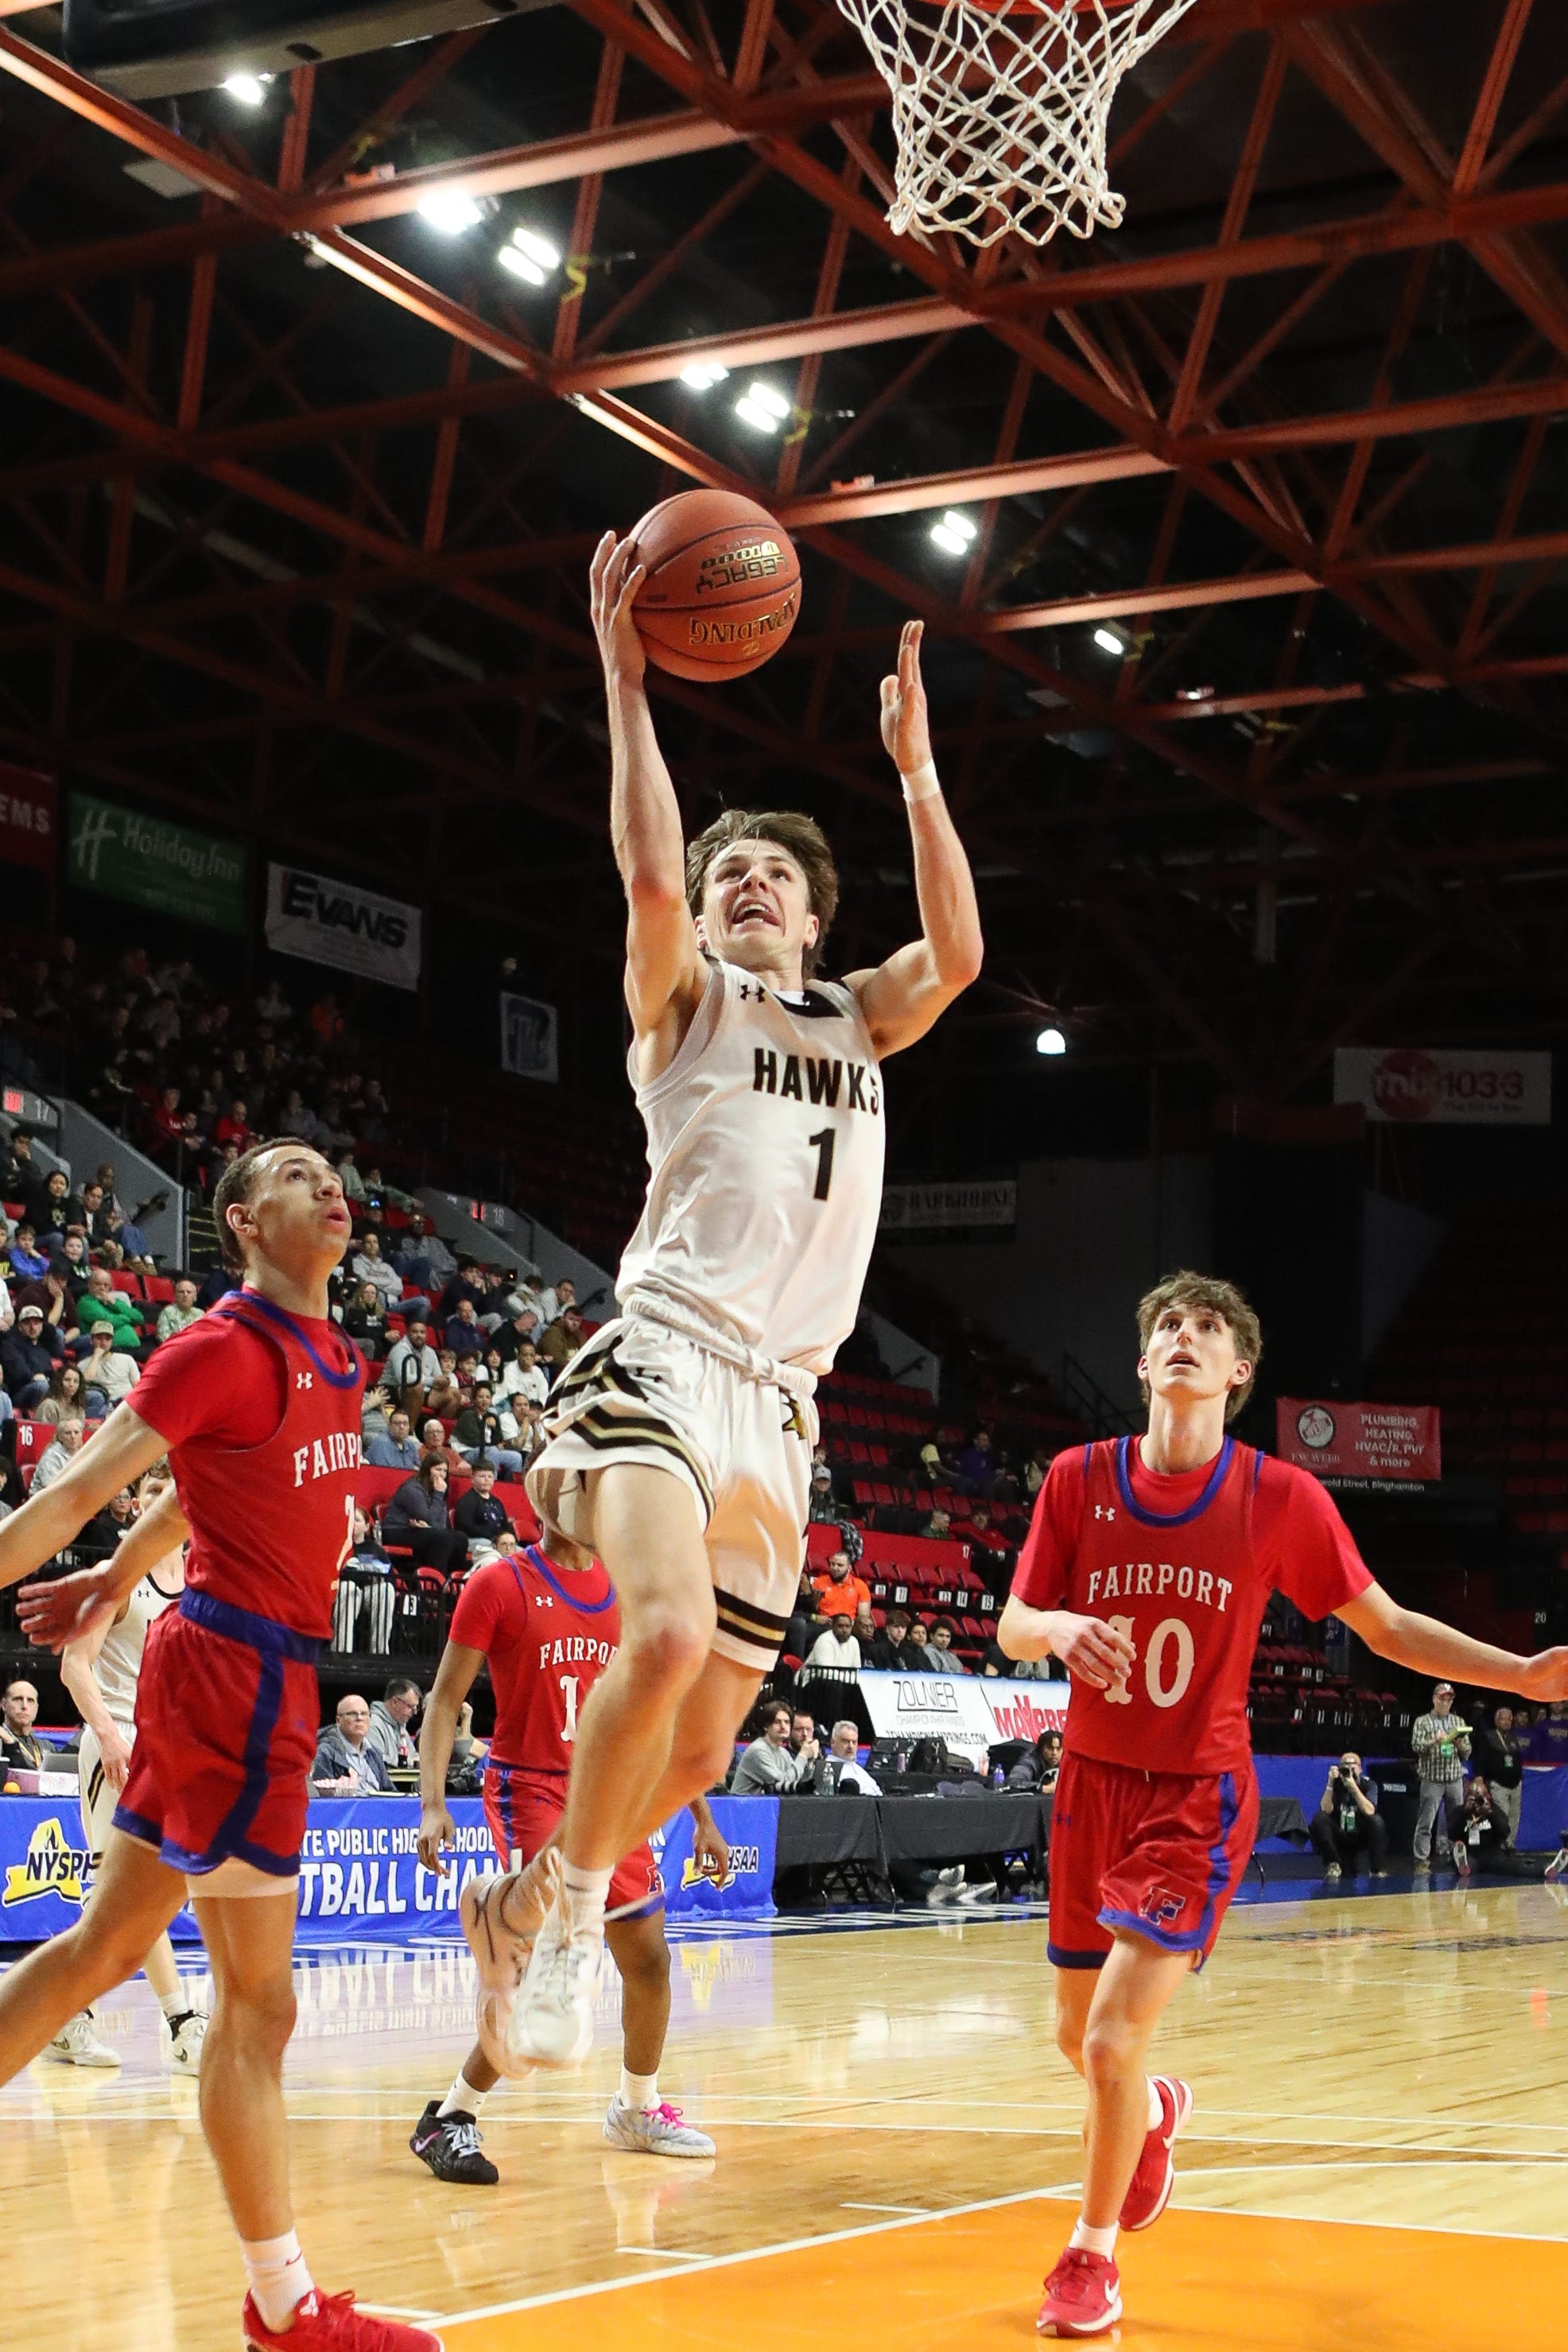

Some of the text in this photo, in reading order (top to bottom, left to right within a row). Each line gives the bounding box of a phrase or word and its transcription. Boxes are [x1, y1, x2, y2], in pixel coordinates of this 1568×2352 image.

[696, 555, 789, 595] LEGACY
[122, 815, 240, 880] Holiday Inn
[282, 874, 408, 947] EVANS
[753, 1047, 879, 1116] HAWKS
[809, 1127, 836, 1201] 1
[19, 1424, 33, 1446] 16
[1369, 1457, 1411, 1468] & more
[1372, 1480, 1425, 1492] Binghamton
[1086, 1563, 1232, 1613] FAIRPORT
[1535, 1612, 1547, 1624] 20
[1103, 1614, 1195, 1708] 10
[893, 1680, 959, 1712] ZOLNIER
[327, 1826, 388, 1856] PUBLIC
[392, 1826, 418, 1854] HIG
[299, 1860, 406, 1917] TBALL
[1139, 1885, 1186, 1927] F
